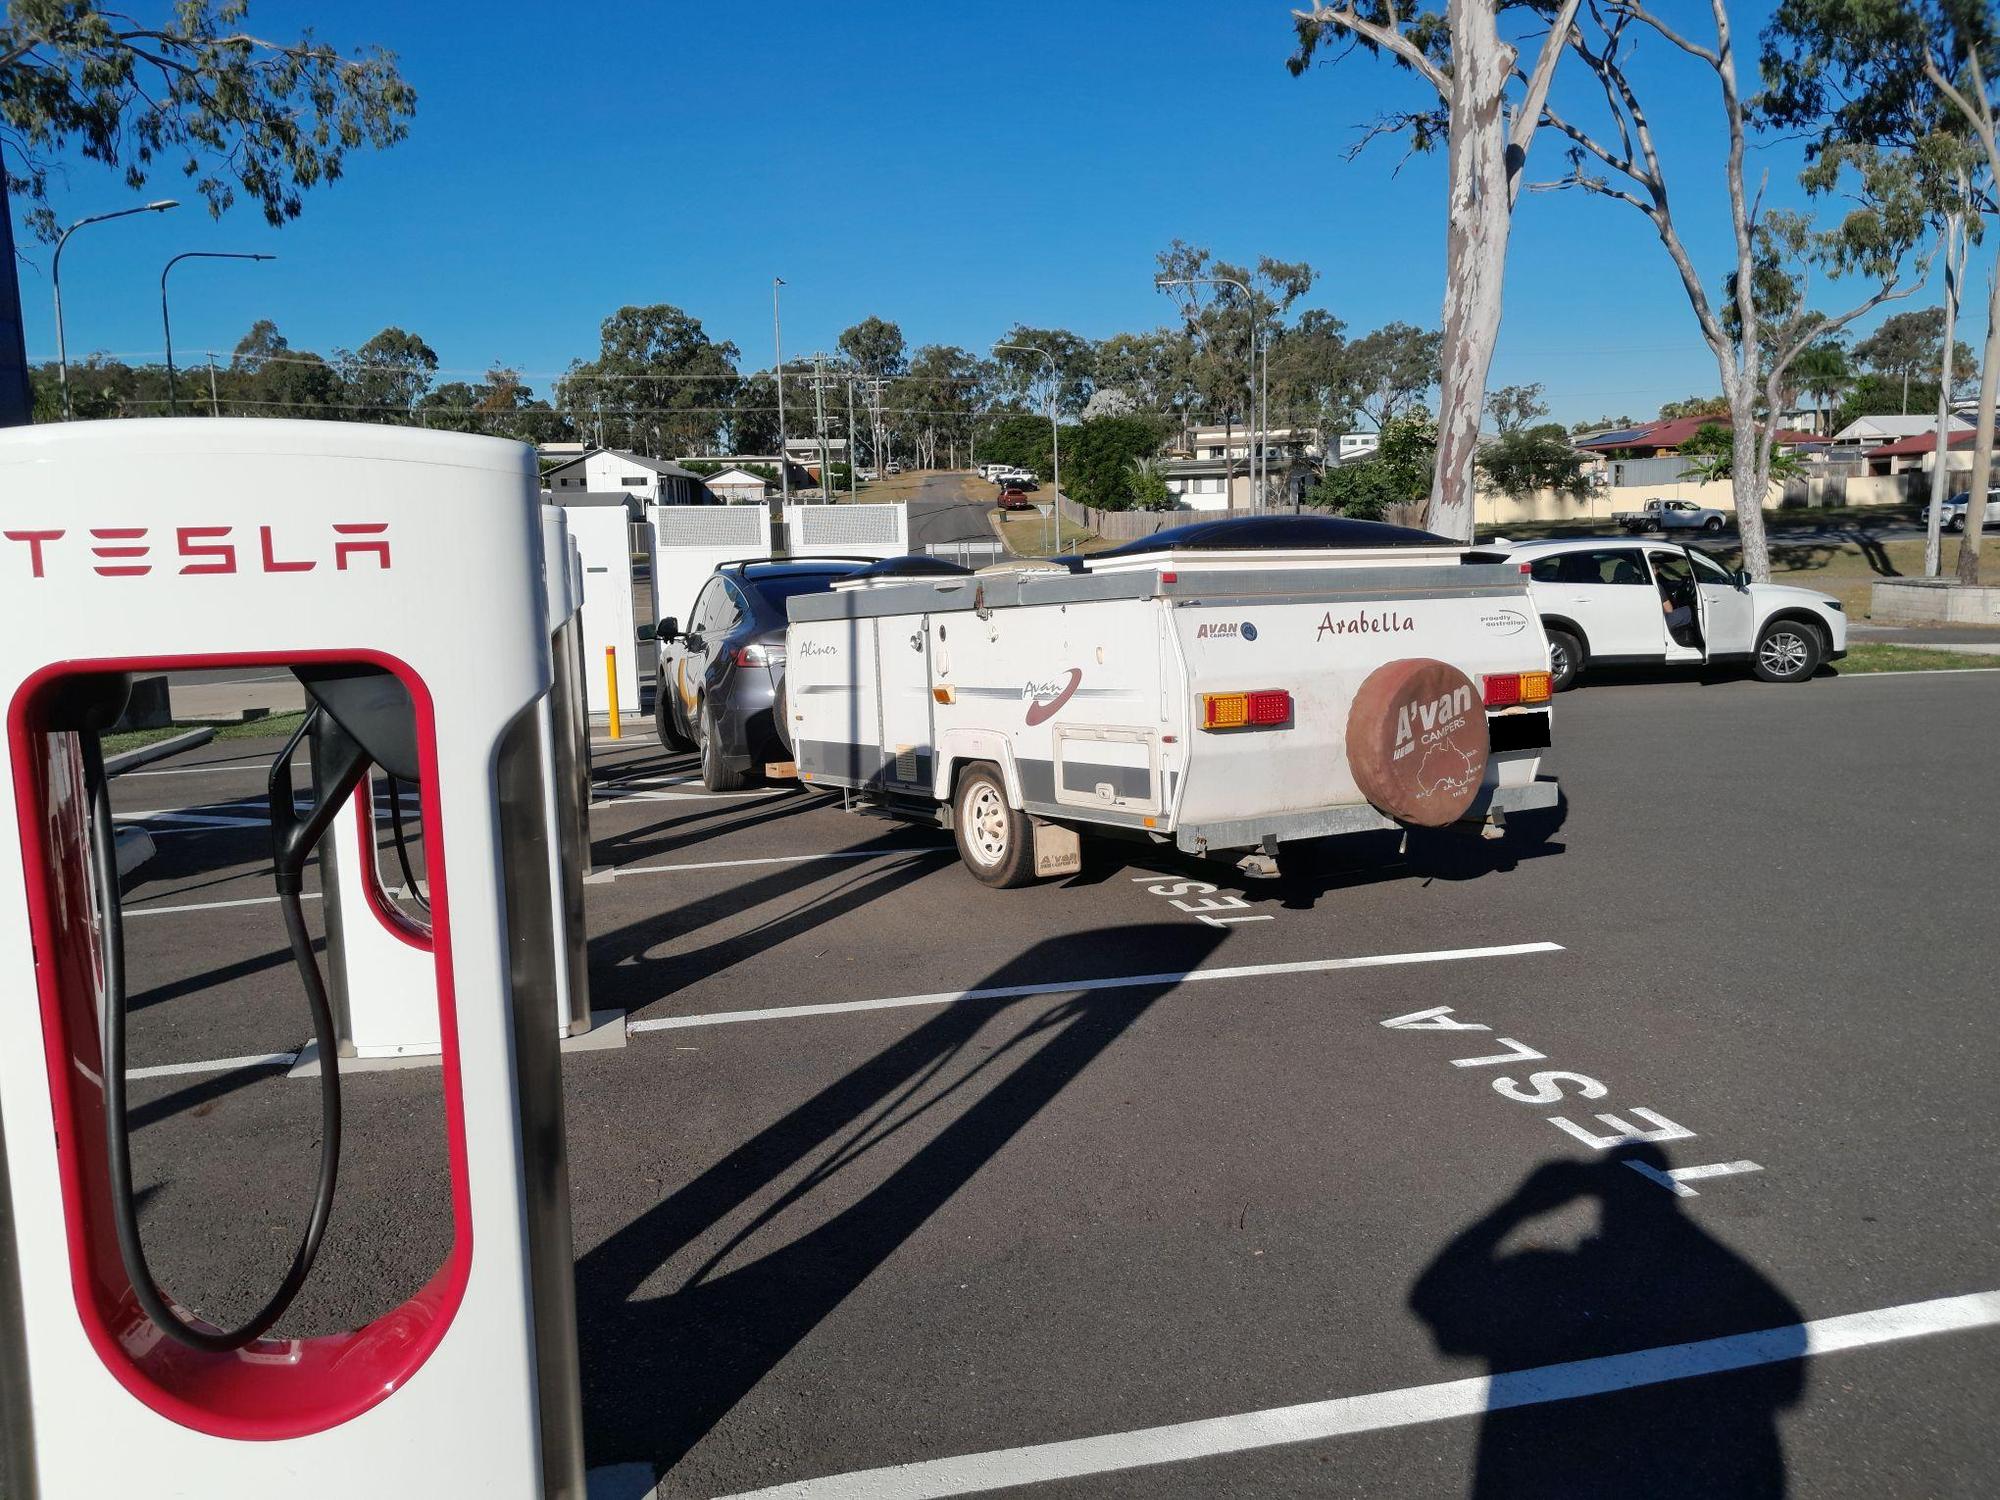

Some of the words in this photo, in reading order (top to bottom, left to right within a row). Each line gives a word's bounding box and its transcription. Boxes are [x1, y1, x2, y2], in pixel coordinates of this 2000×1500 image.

[3, 523, 391, 578] TESLA
[1197, 623, 1237, 638] AVAN
[1317, 609, 1414, 642] Arabella
[800, 640, 839, 660] Aliner
[1421, 717, 1466, 744] CAMPERS
[1379, 1005, 1765, 1198] TESLA
